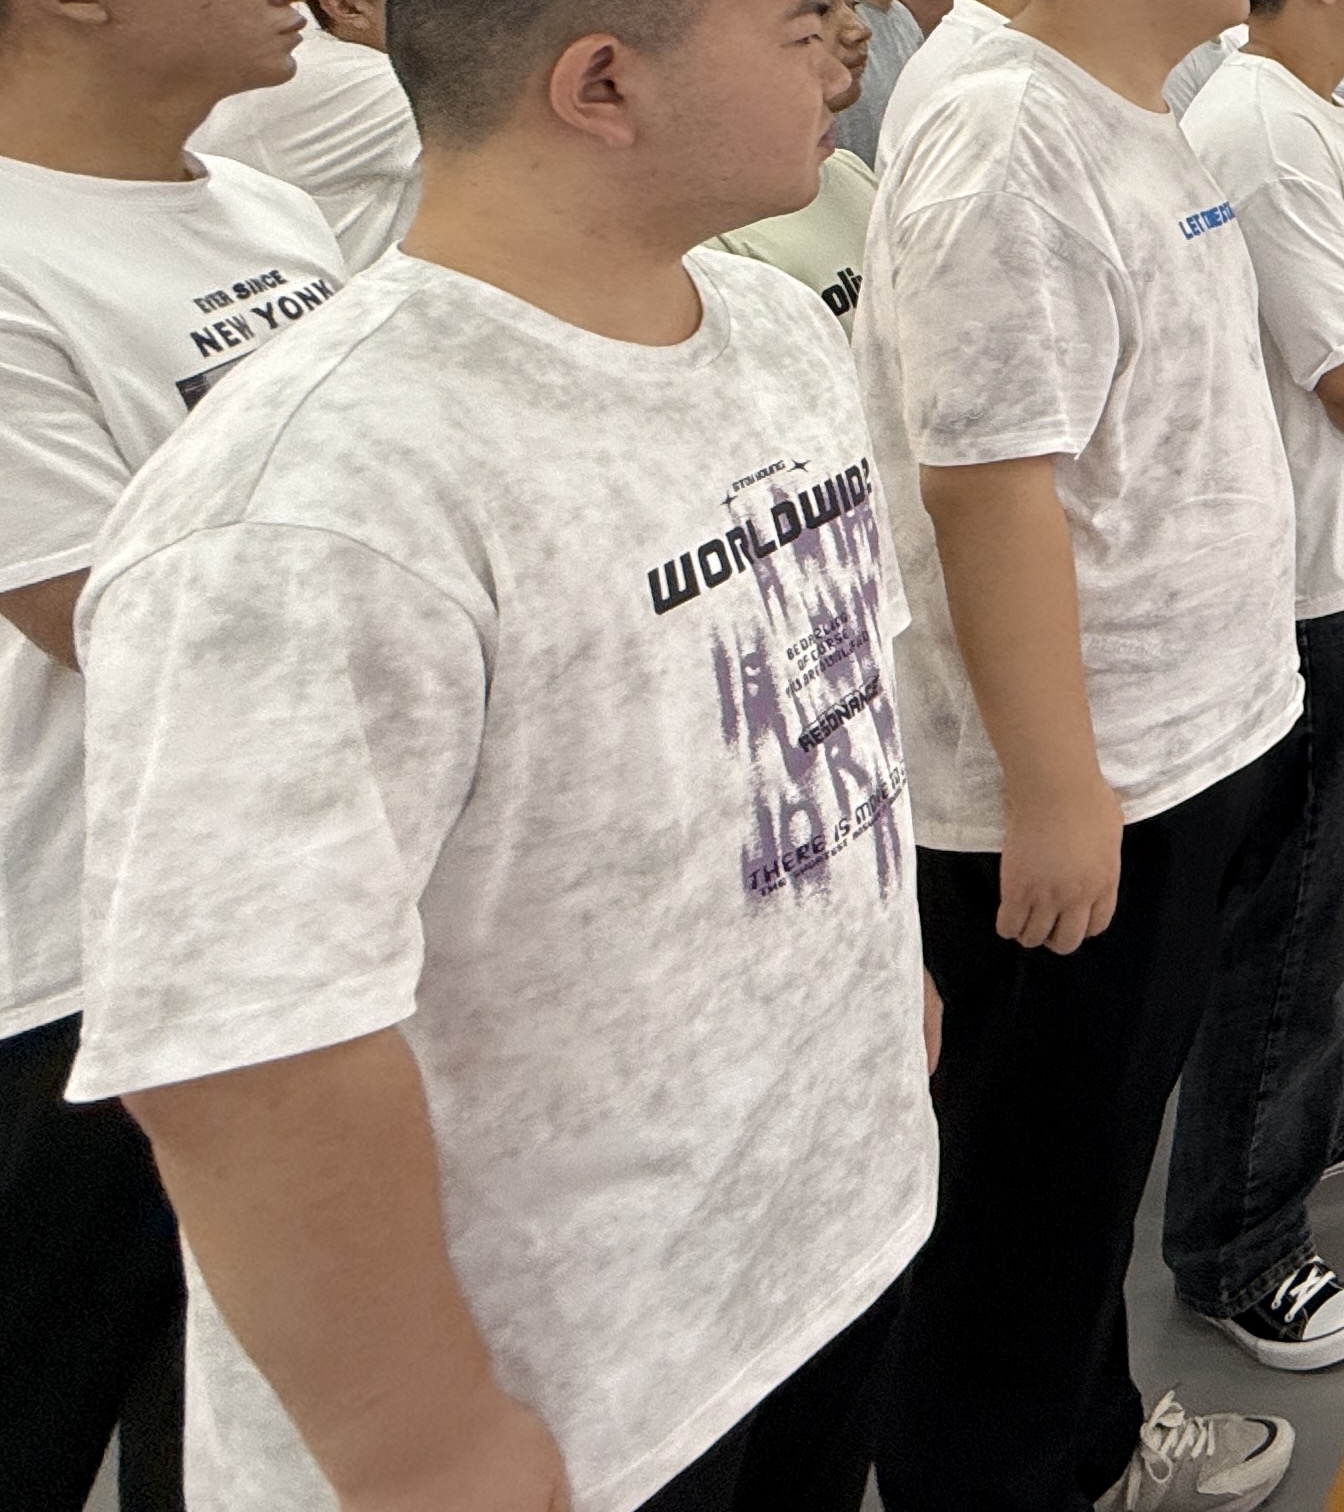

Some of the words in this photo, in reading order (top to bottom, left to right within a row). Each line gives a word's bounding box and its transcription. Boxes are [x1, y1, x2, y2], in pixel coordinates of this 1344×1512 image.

[232, 269, 288, 300] SINCE
[190, 314, 255, 358] NEW
[749, 835, 826, 890] THERE
[835, 817, 851, 843] IS
